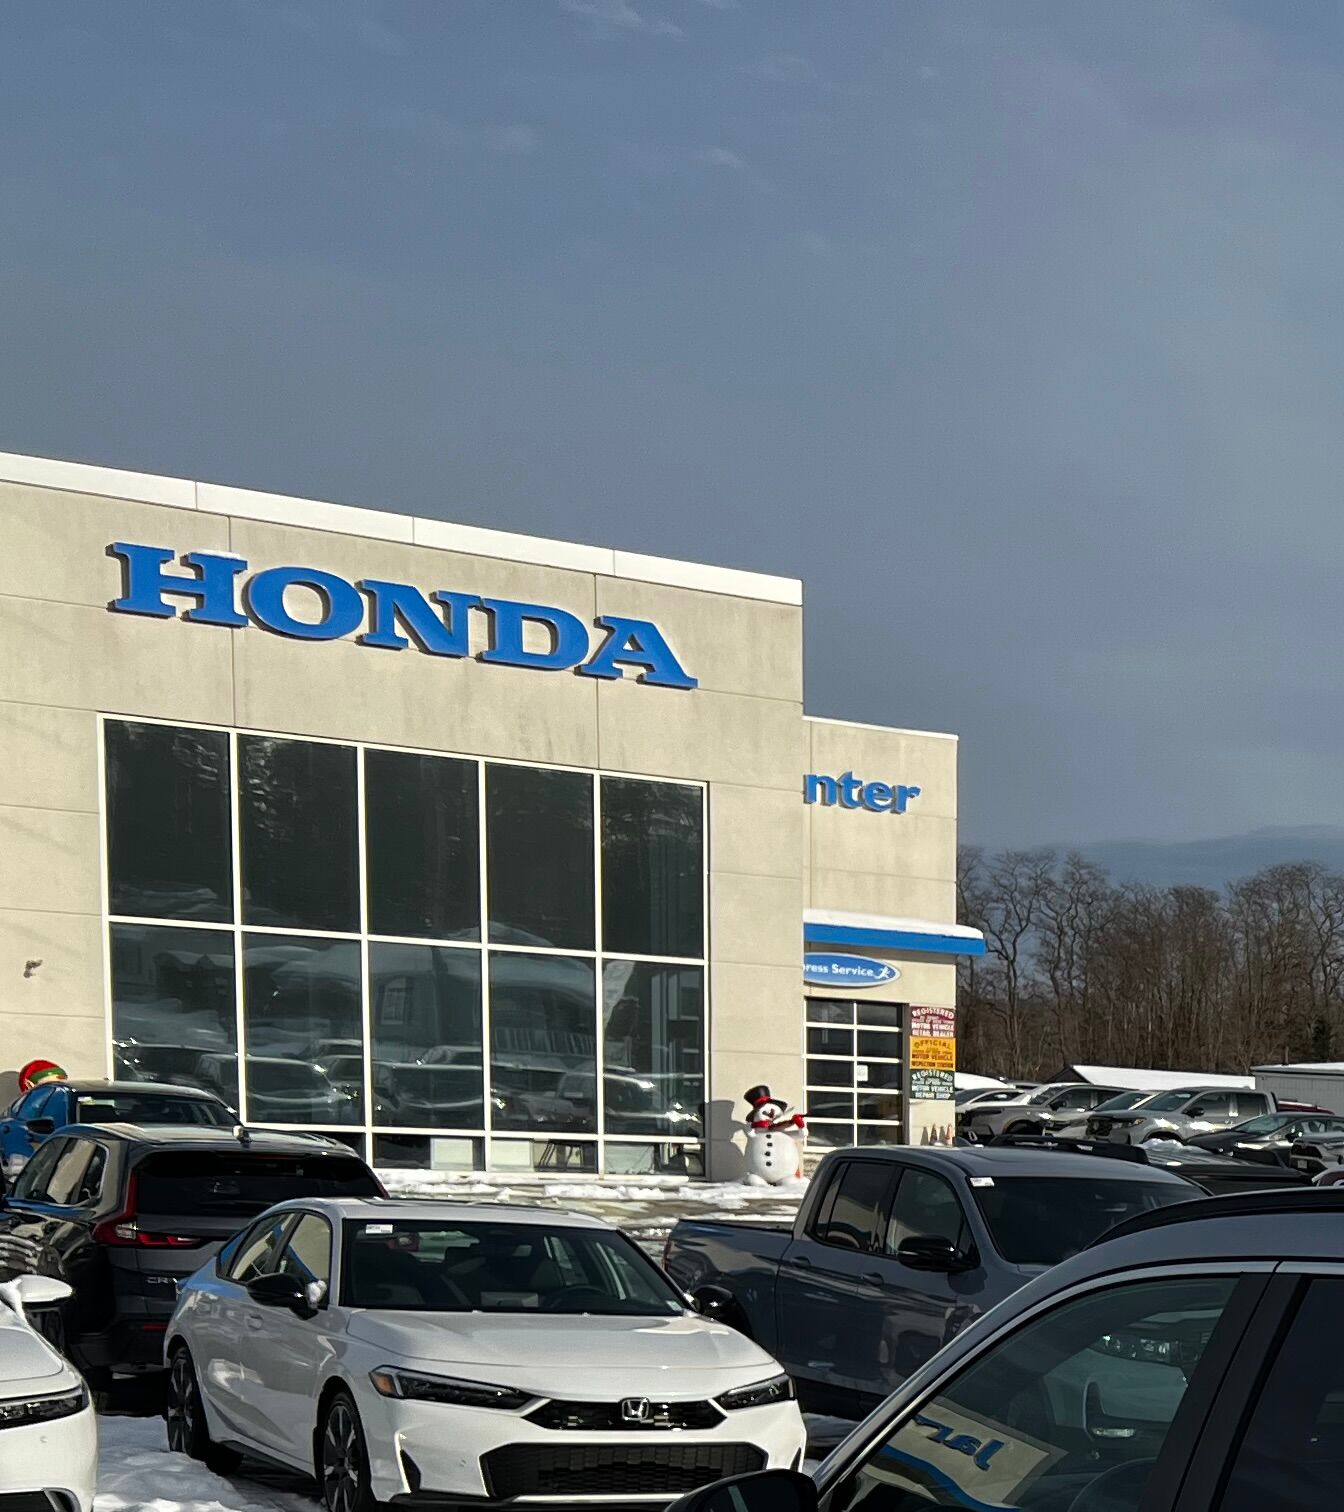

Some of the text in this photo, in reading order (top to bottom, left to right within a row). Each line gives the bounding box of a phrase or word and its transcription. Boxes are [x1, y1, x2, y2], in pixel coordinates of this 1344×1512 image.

[107, 542, 698, 689] HONDA
[803, 770, 921, 814] nter
[831, 963, 874, 977] Service
[913, 1039, 952, 1049] OFFICIAL
